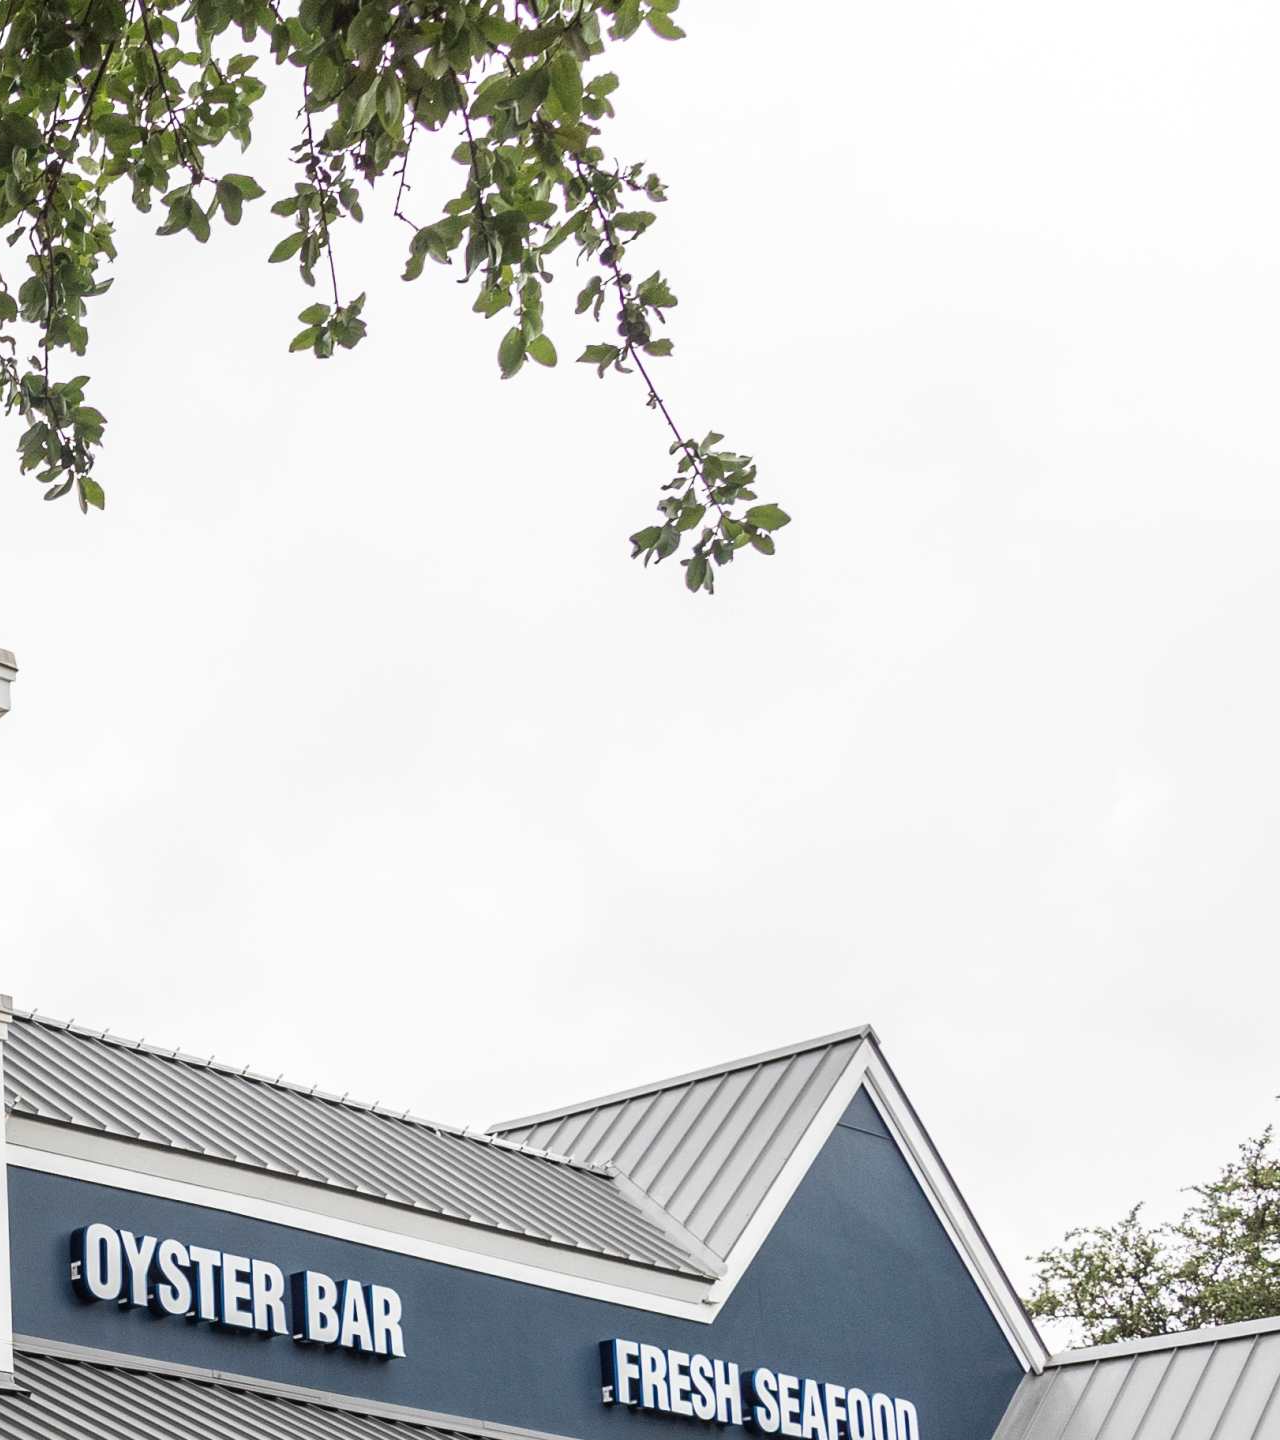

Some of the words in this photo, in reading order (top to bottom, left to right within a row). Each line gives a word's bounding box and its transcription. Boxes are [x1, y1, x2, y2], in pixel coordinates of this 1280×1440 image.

[85, 1222, 289, 1335] OYSTER
[305, 1269, 407, 1358] BAR
[614, 1338, 743, 1426] FRESH
